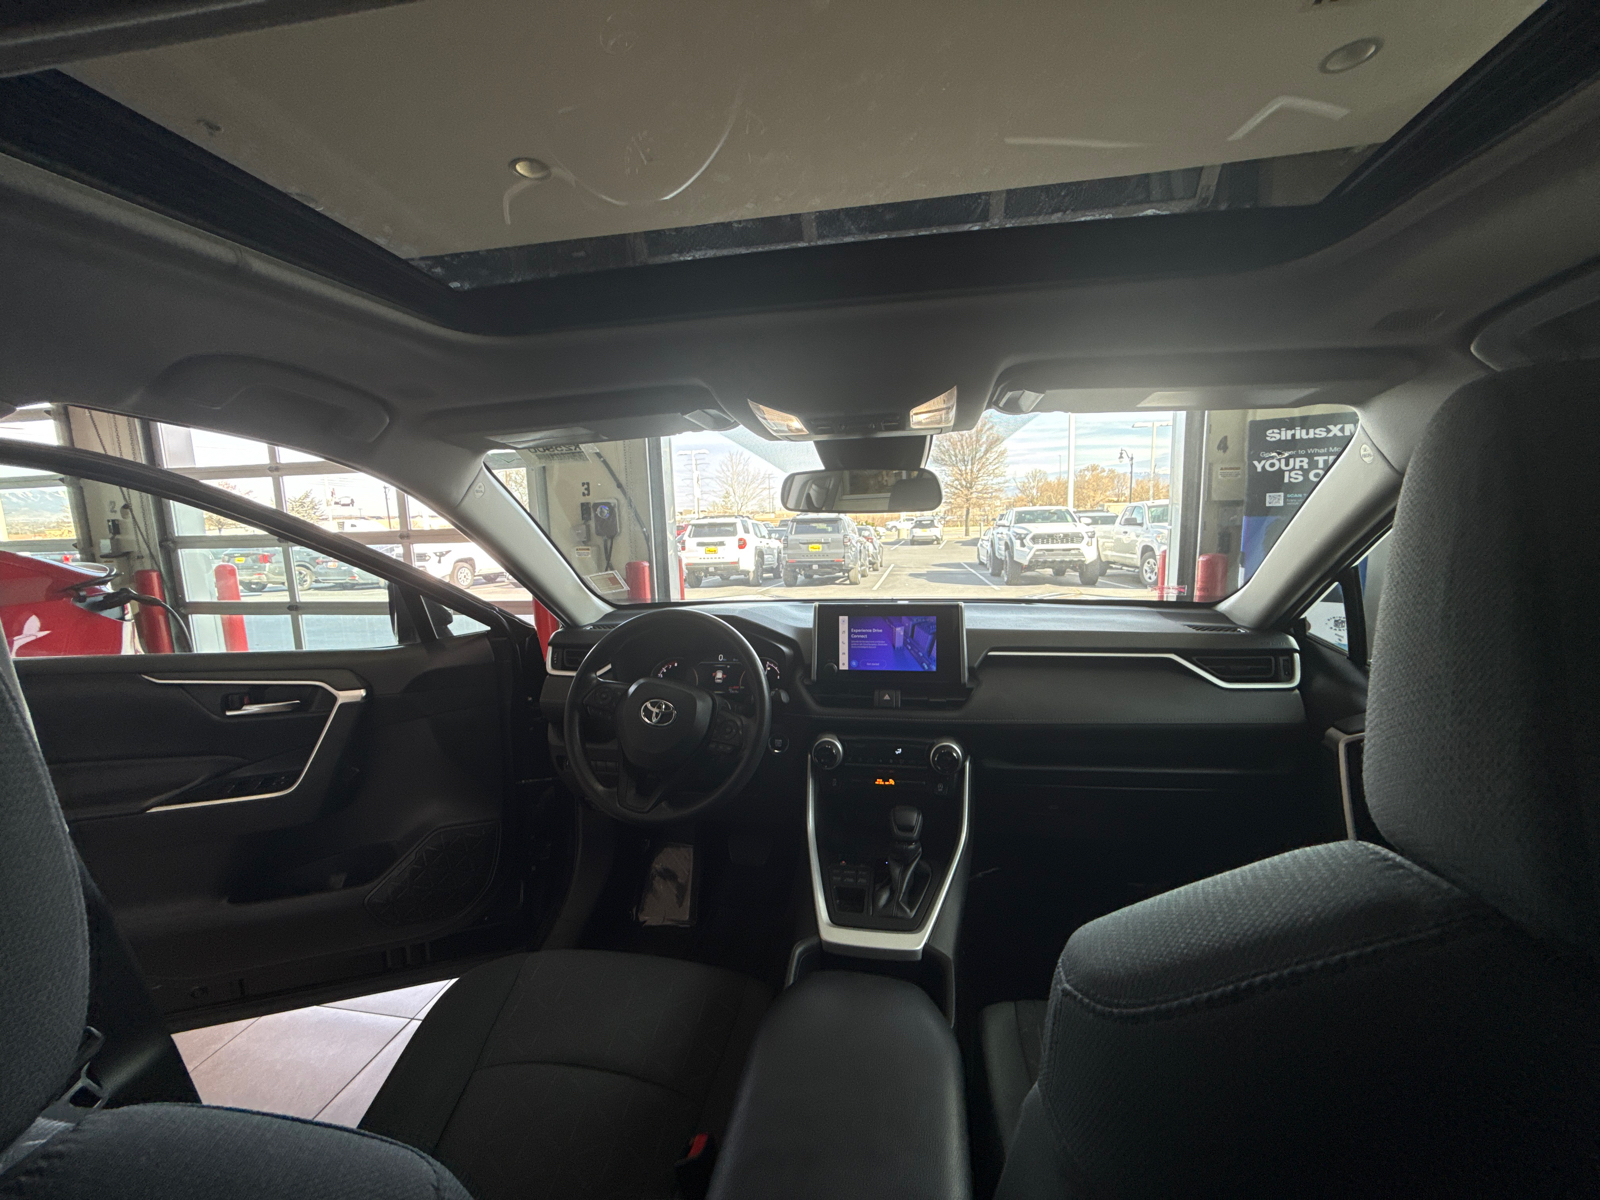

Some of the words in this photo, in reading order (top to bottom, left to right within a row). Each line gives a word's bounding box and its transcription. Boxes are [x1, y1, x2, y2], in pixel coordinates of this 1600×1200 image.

[1216, 435, 1229, 454] 4
[1252, 457, 1309, 472] YOUR
[1283, 470, 1304, 483] IS
[581, 481, 591, 497] 3
[109, 500, 118, 514] 2
